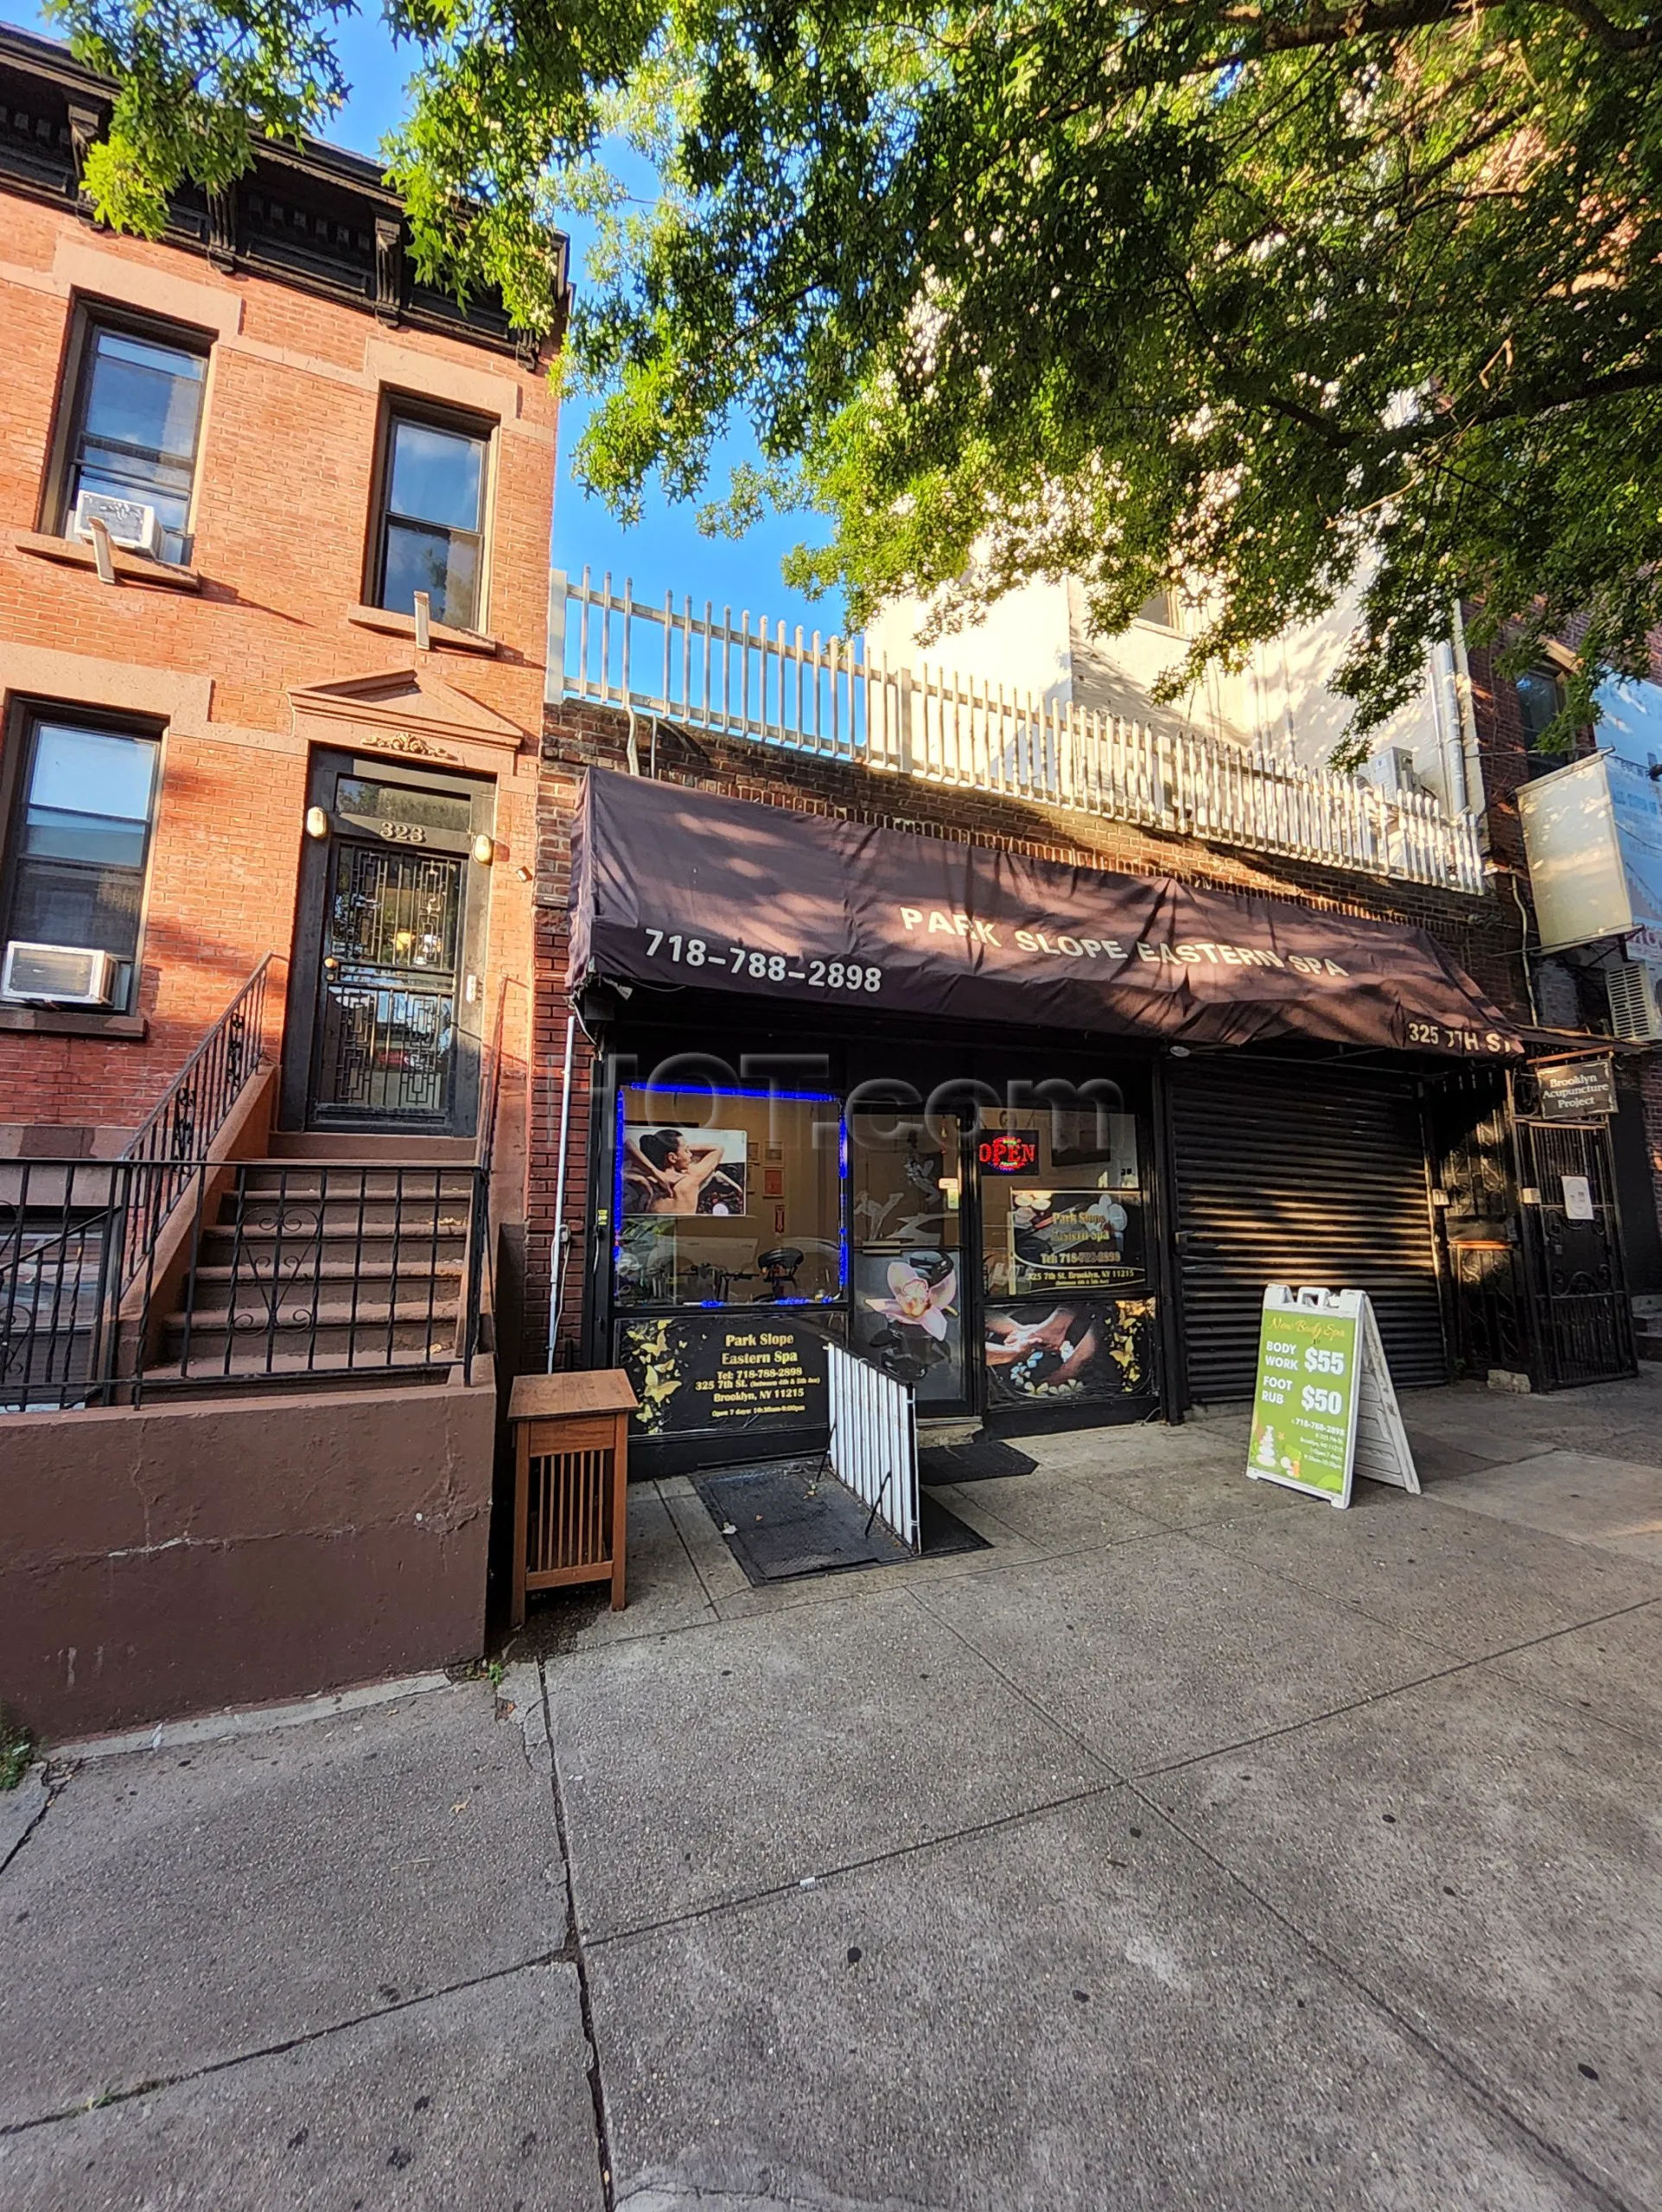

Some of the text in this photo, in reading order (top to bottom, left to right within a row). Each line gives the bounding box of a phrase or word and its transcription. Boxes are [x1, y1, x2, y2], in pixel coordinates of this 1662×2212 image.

[380, 821, 423, 842] 323
[900, 907, 1350, 977] PARK SLOPE EASTERN SPA
[646, 928, 882, 993] 718-788-2898
[1408, 1023, 1439, 1045] 325
[1550, 1074, 1598, 1088] Brooklyn
[1543, 1084, 1609, 1099] Acupuncture
[1557, 1096, 1595, 1109] Project
[978, 1143, 1035, 1163] OPEN
[1053, 1211, 1077, 1224] Park
[1090, 1229, 1111, 1243] Spa
[1044, 1272, 1056, 1281] 7th
[1295, 1319, 1322, 1340] Body
[1323, 1324, 1347, 1342] Spa
[725, 1332, 794, 1347] Park Slope
[1266, 1340, 1297, 1355] BODY
[722, 1351, 799, 1365] Eastern Spa
[1264, 1355, 1299, 1371] WORK
[1304, 1346, 1345, 1376] $55
[736, 1367, 803, 1380] 718-788-2898
[695, 1381, 715, 1391] 325
[717, 1379, 734, 1389] 7th
[1263, 1375, 1294, 1391] FOOT
[713, 1388, 805, 1403] Brooklyn, NY 11215
[1261, 1389, 1284, 1405] RUB
[1301, 1384, 1342, 1415] $50
